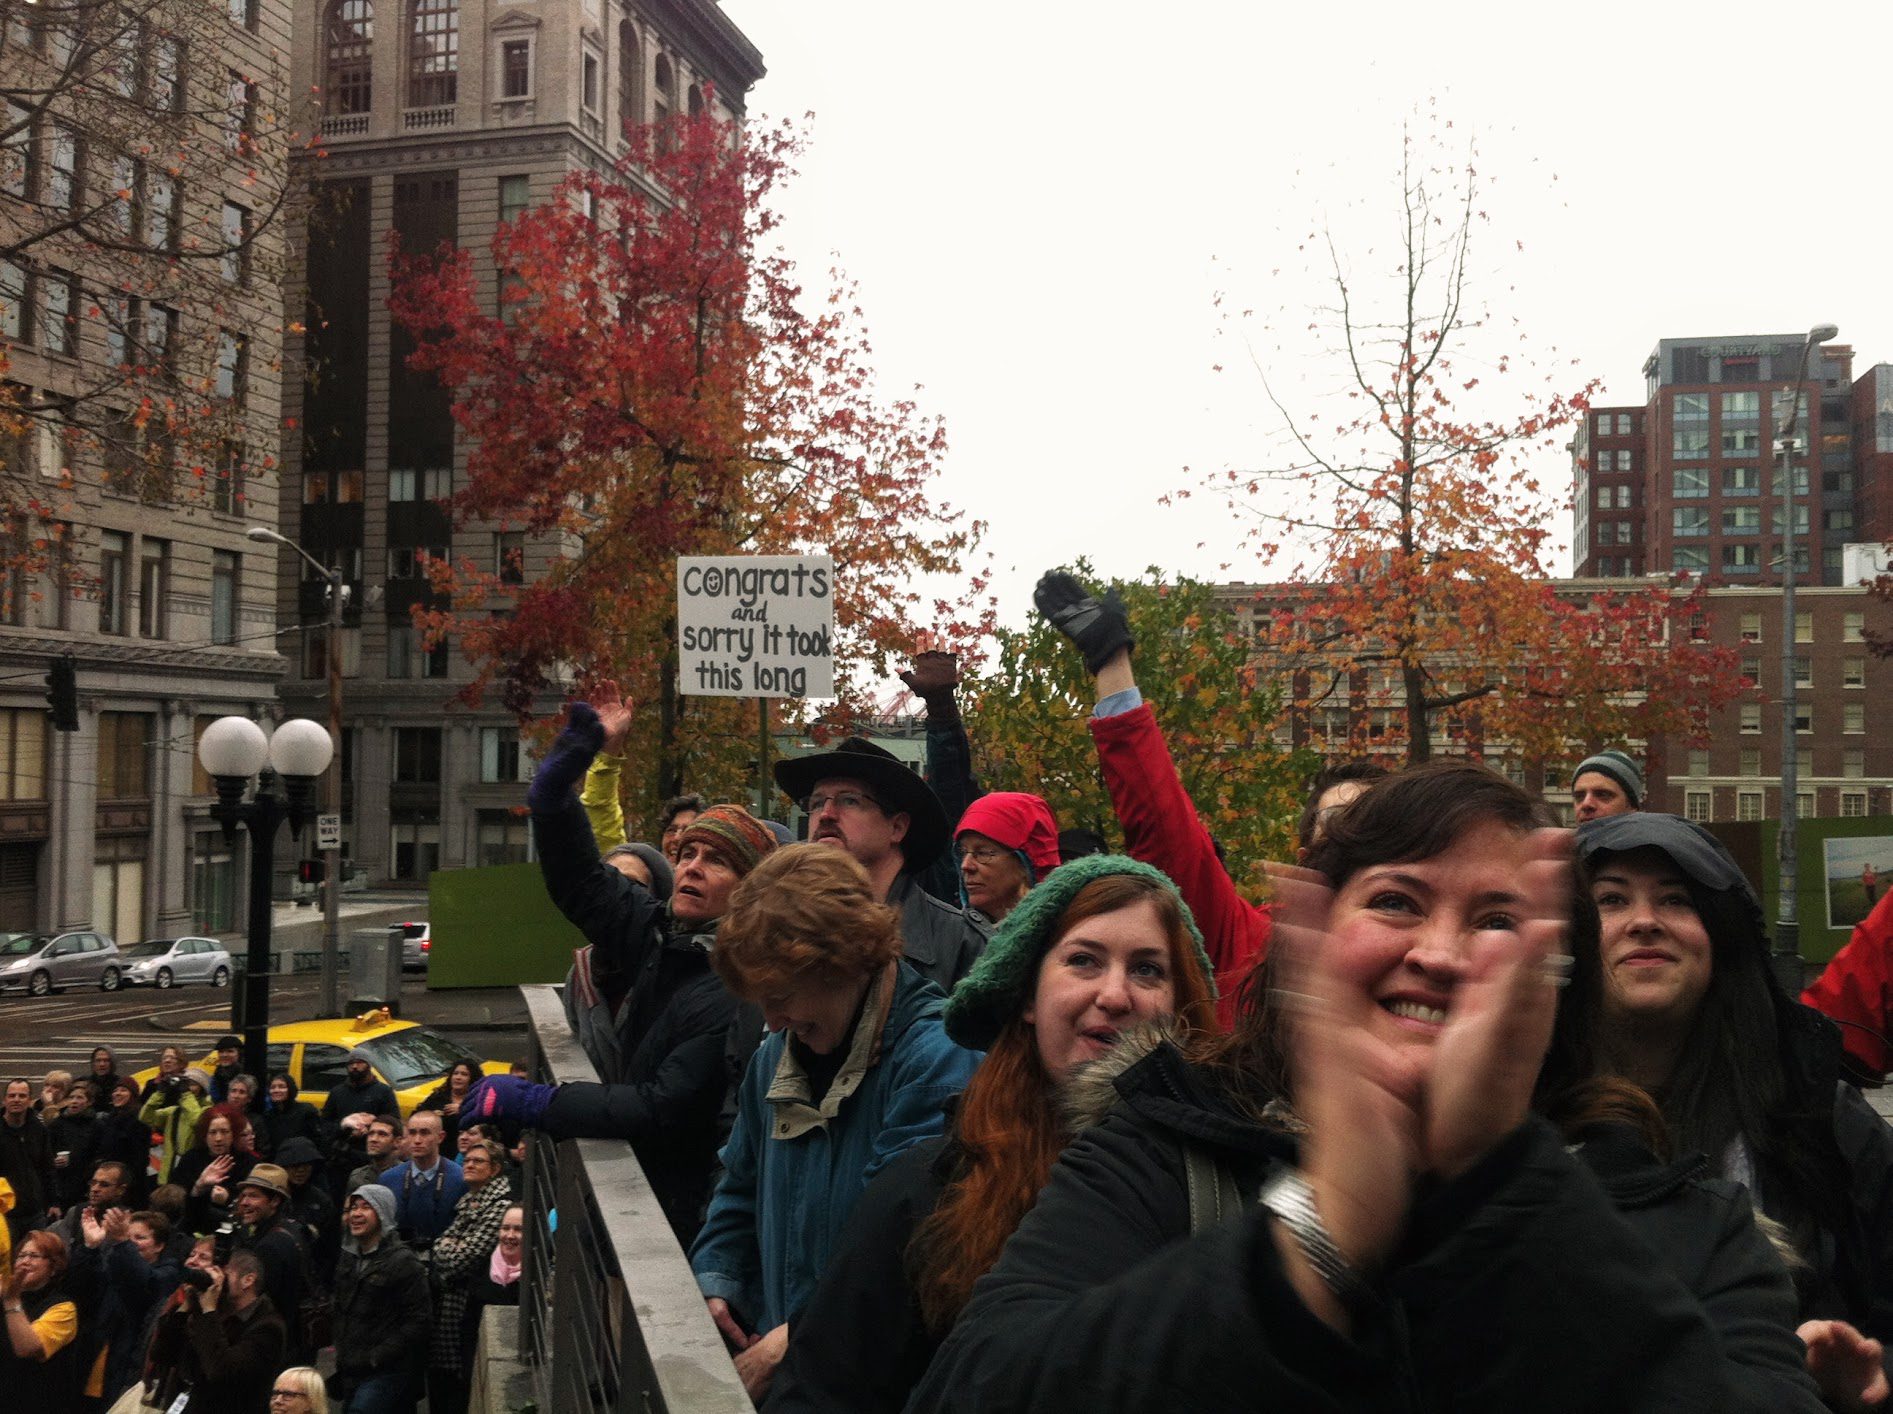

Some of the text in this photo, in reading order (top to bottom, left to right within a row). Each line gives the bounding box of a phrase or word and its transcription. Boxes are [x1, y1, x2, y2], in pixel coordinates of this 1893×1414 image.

[731, 600, 768, 622] and
[683, 623, 832, 663] sorry it took
[695, 660, 806, 698] this long
[320, 817, 337, 825] ONE
[320, 827, 338, 835] WAY
